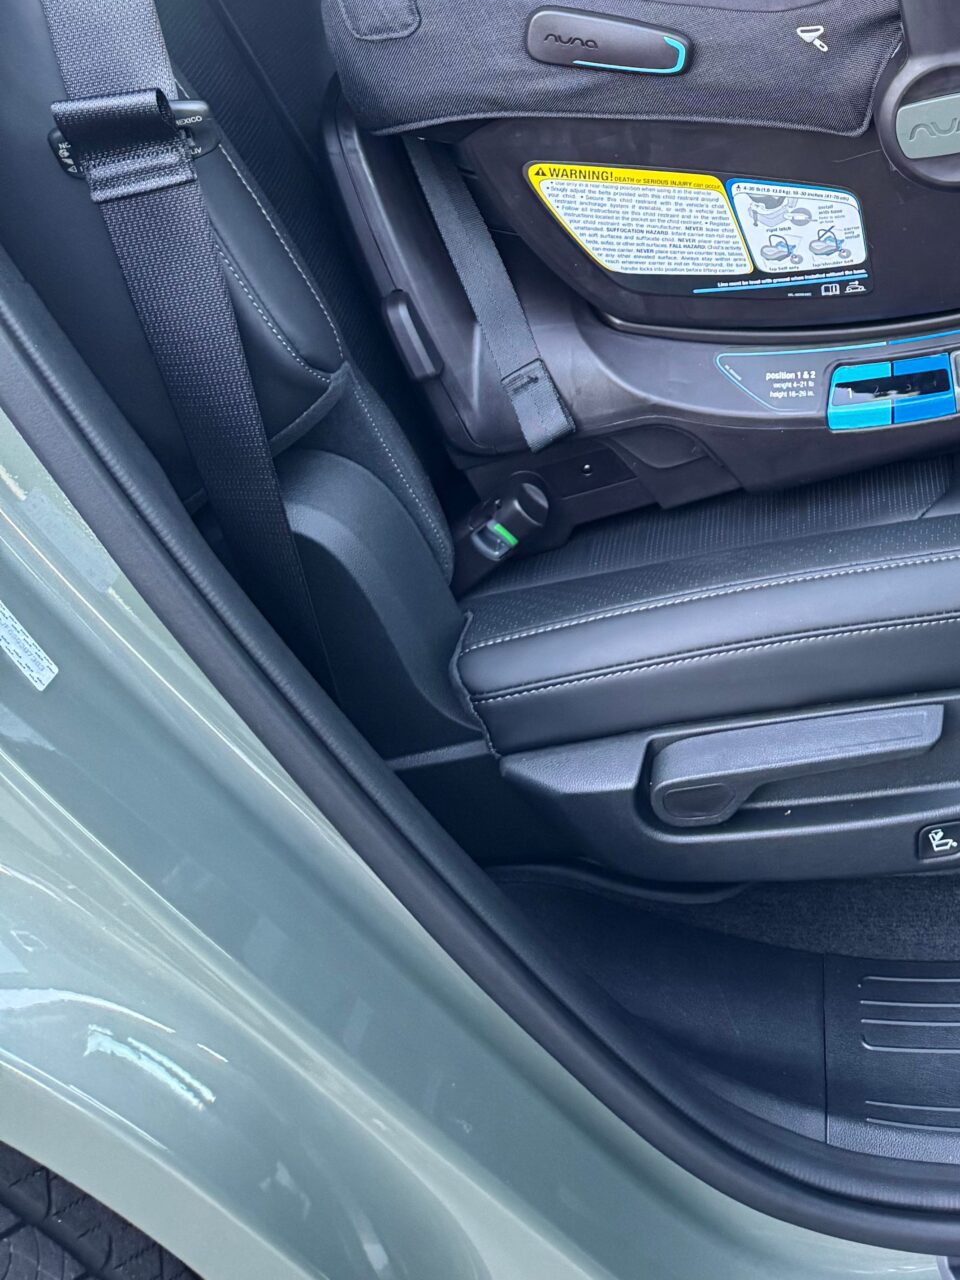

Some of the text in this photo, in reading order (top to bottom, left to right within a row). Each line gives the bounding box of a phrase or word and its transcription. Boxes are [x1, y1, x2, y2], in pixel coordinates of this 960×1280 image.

[544, 33, 599, 49] nuna
[549, 167, 613, 181] WARNING!
[643, 178, 668, 186] SERIOUS
[765, 372, 796, 381] position
[802, 371, 809, 379] &
[810, 370, 816, 379] 2
[848, 387, 852, 399] 1
